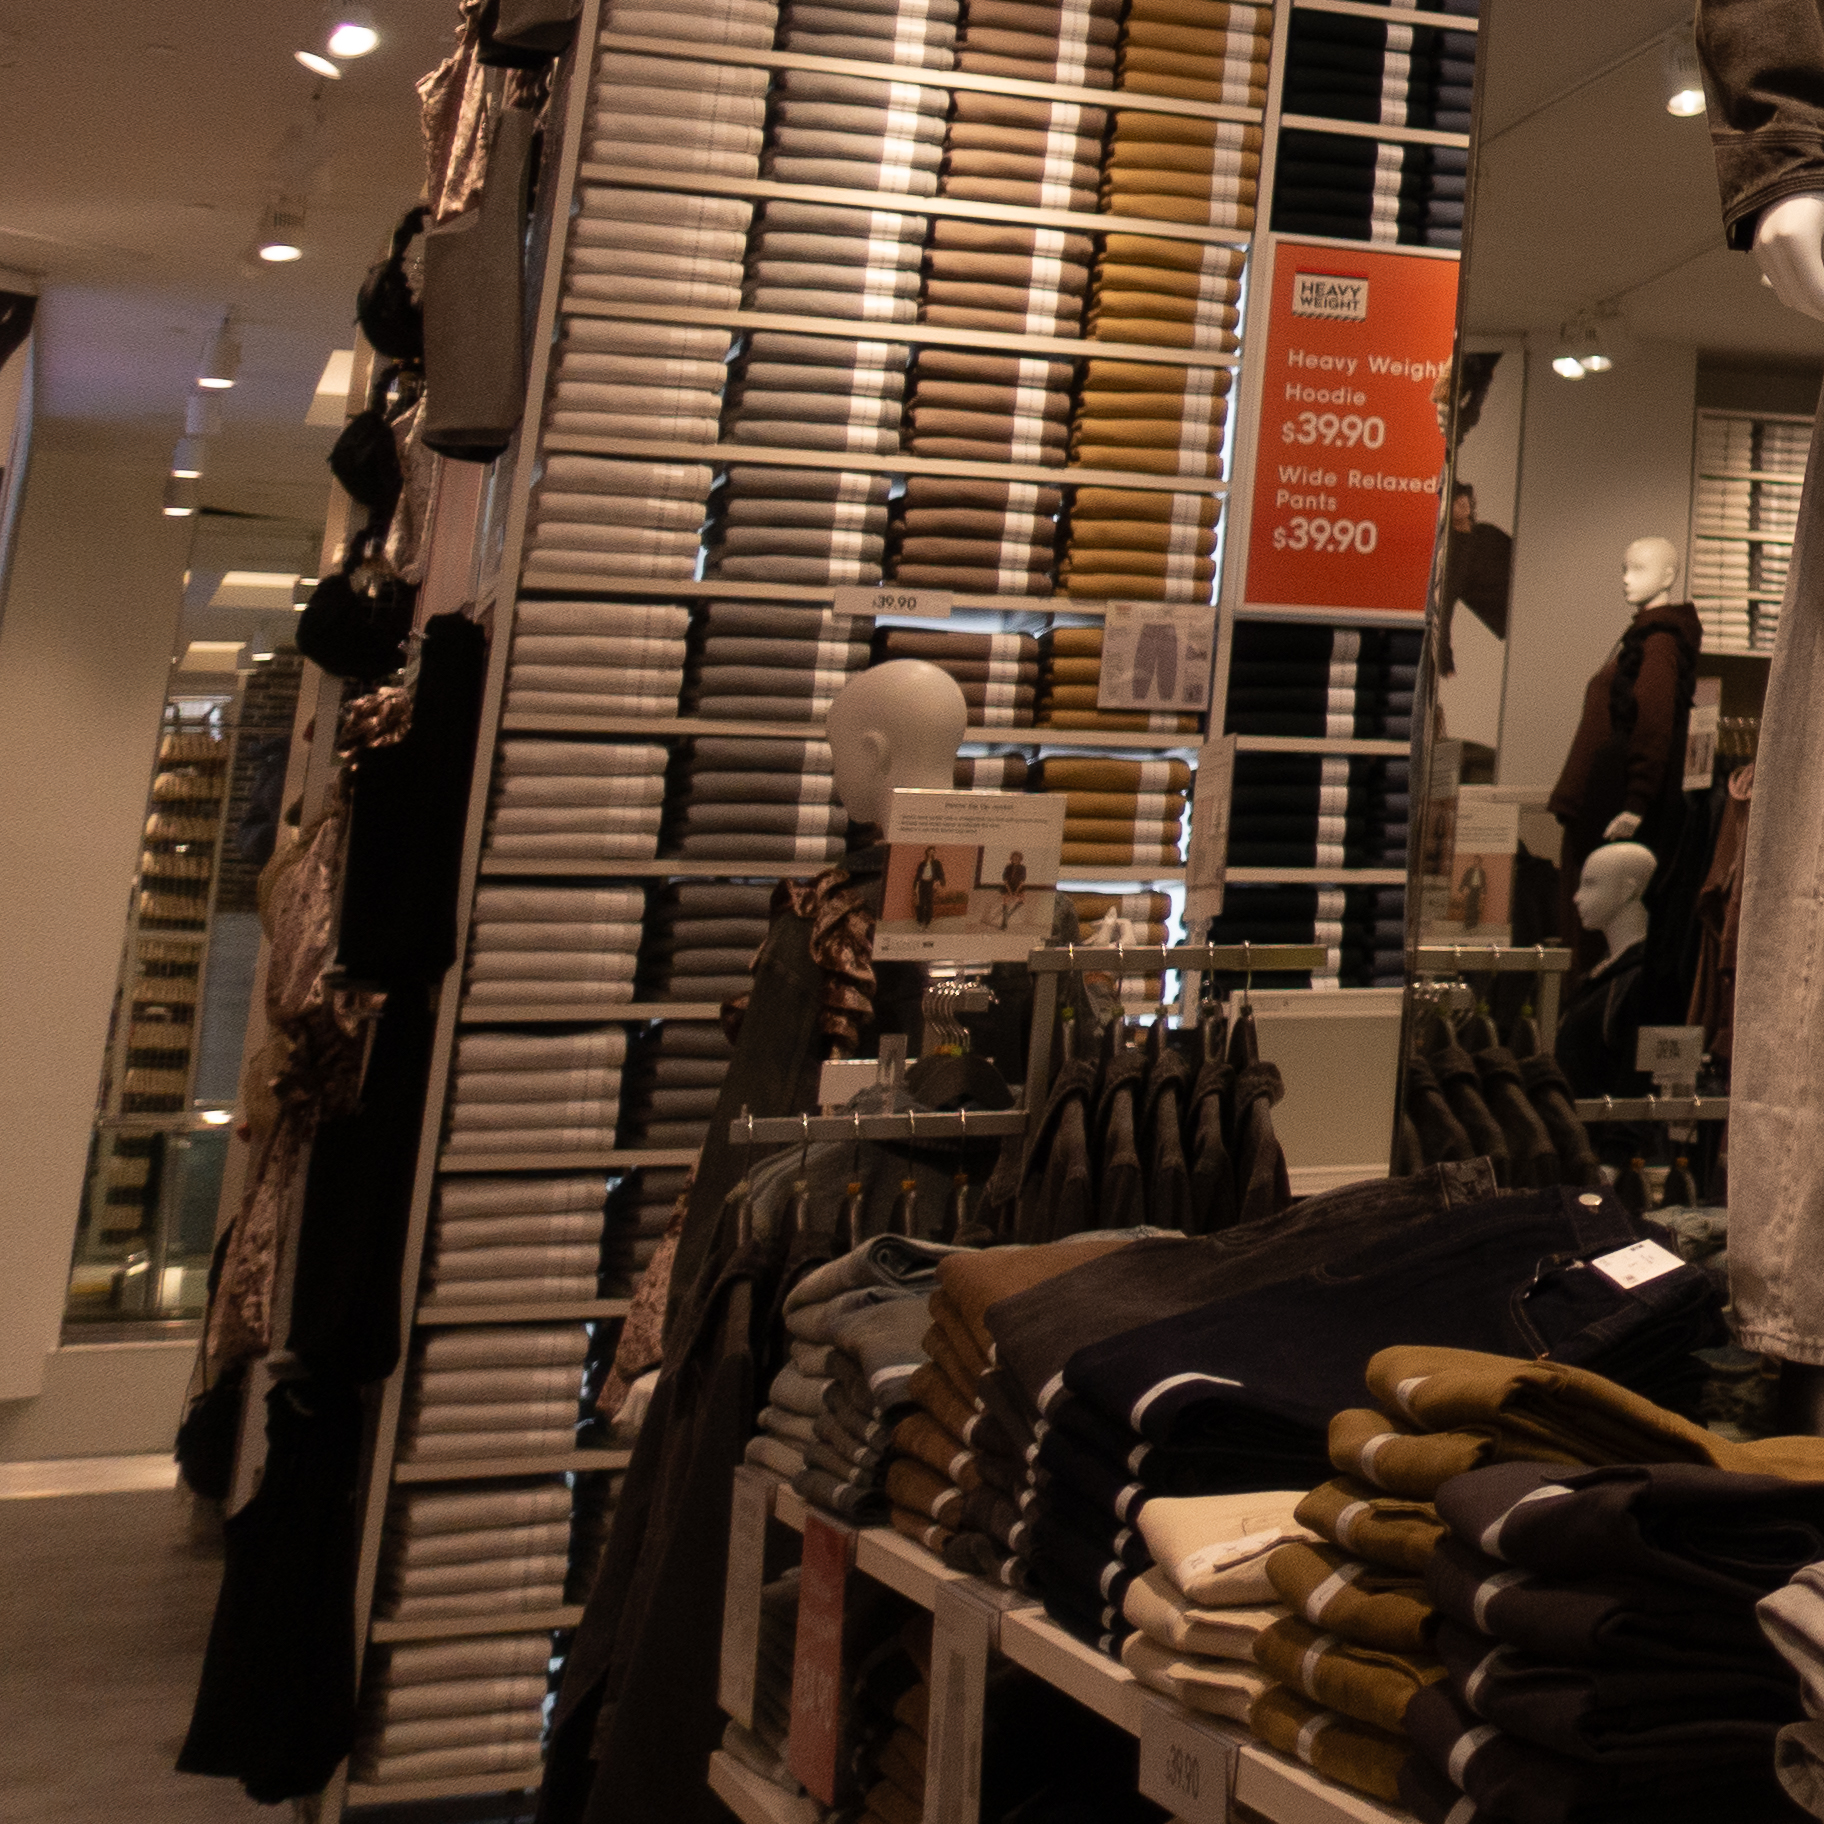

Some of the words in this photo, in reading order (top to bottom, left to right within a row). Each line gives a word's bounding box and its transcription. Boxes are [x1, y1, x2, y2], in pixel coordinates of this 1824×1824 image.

[1300, 281, 1362, 297] HEAVY
[1299, 295, 1361, 312] WEIGHT
[1288, 349, 1358, 376] Heavy
[1285, 383, 1366, 408] Hoodie
[1281, 411, 1386, 450] $39.90
[1278, 465, 1337, 488] Wide
[1347, 468, 1438, 494] Relaxed
[1276, 487, 1337, 512] Pants
[1273, 516, 1378, 554] $39.90
